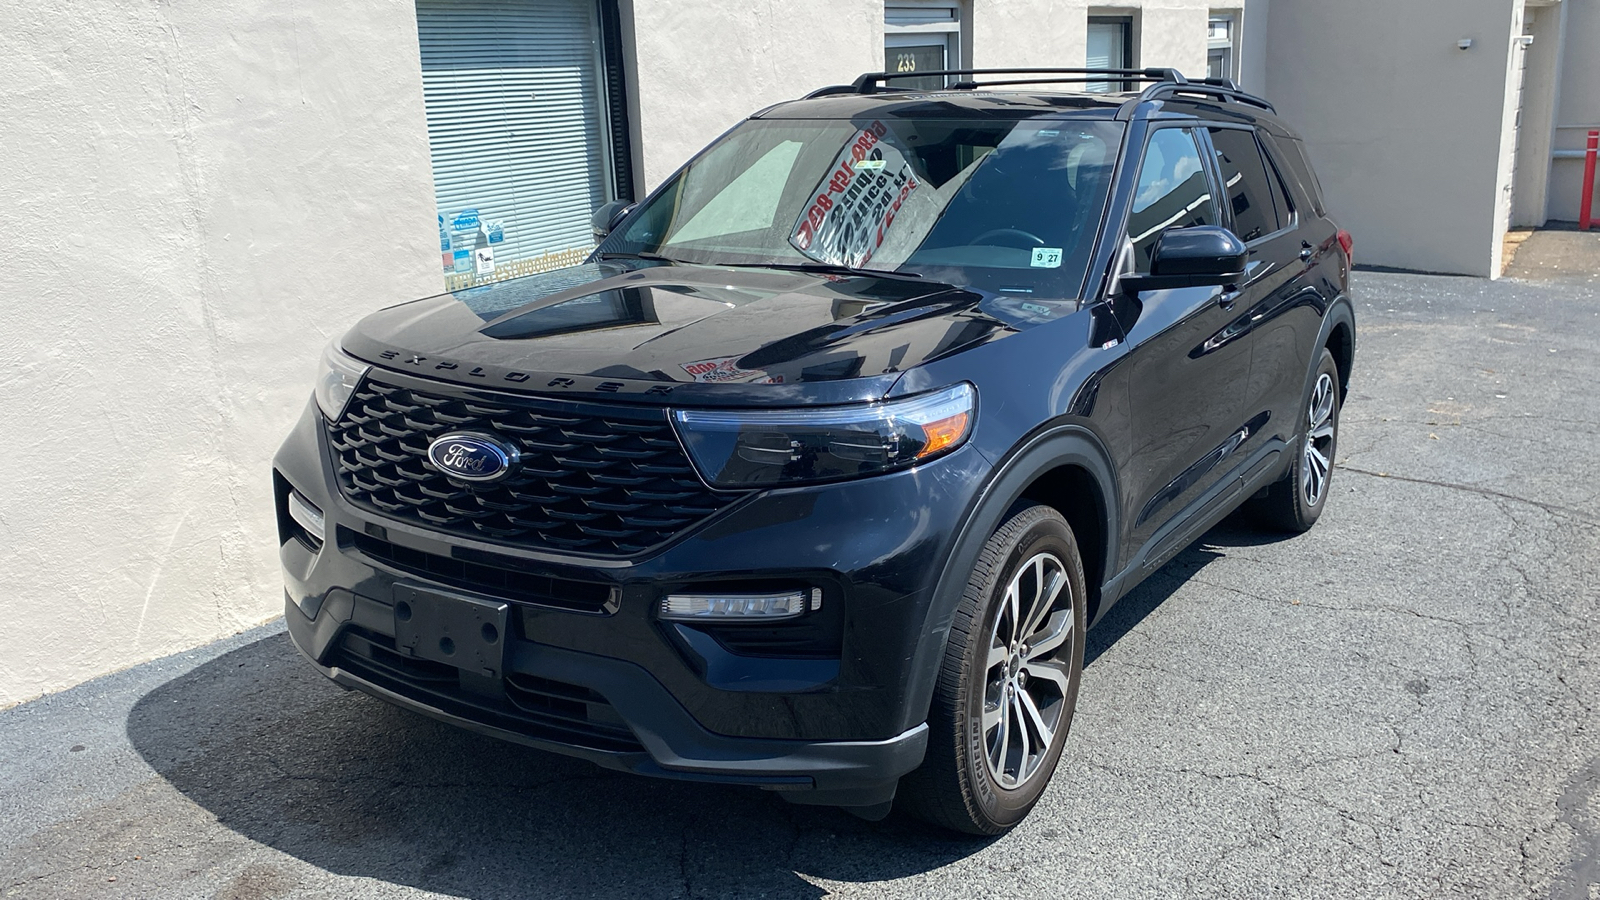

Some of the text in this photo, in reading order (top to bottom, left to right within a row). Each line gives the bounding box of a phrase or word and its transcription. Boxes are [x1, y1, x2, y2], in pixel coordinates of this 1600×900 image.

[897, 53, 916, 72] 233
[1037, 253, 1058, 262] 9 27
[379, 350, 674, 395] EXPLORER
[443, 444, 487, 471] Ford
[973, 722, 989, 796] MICHELIN
